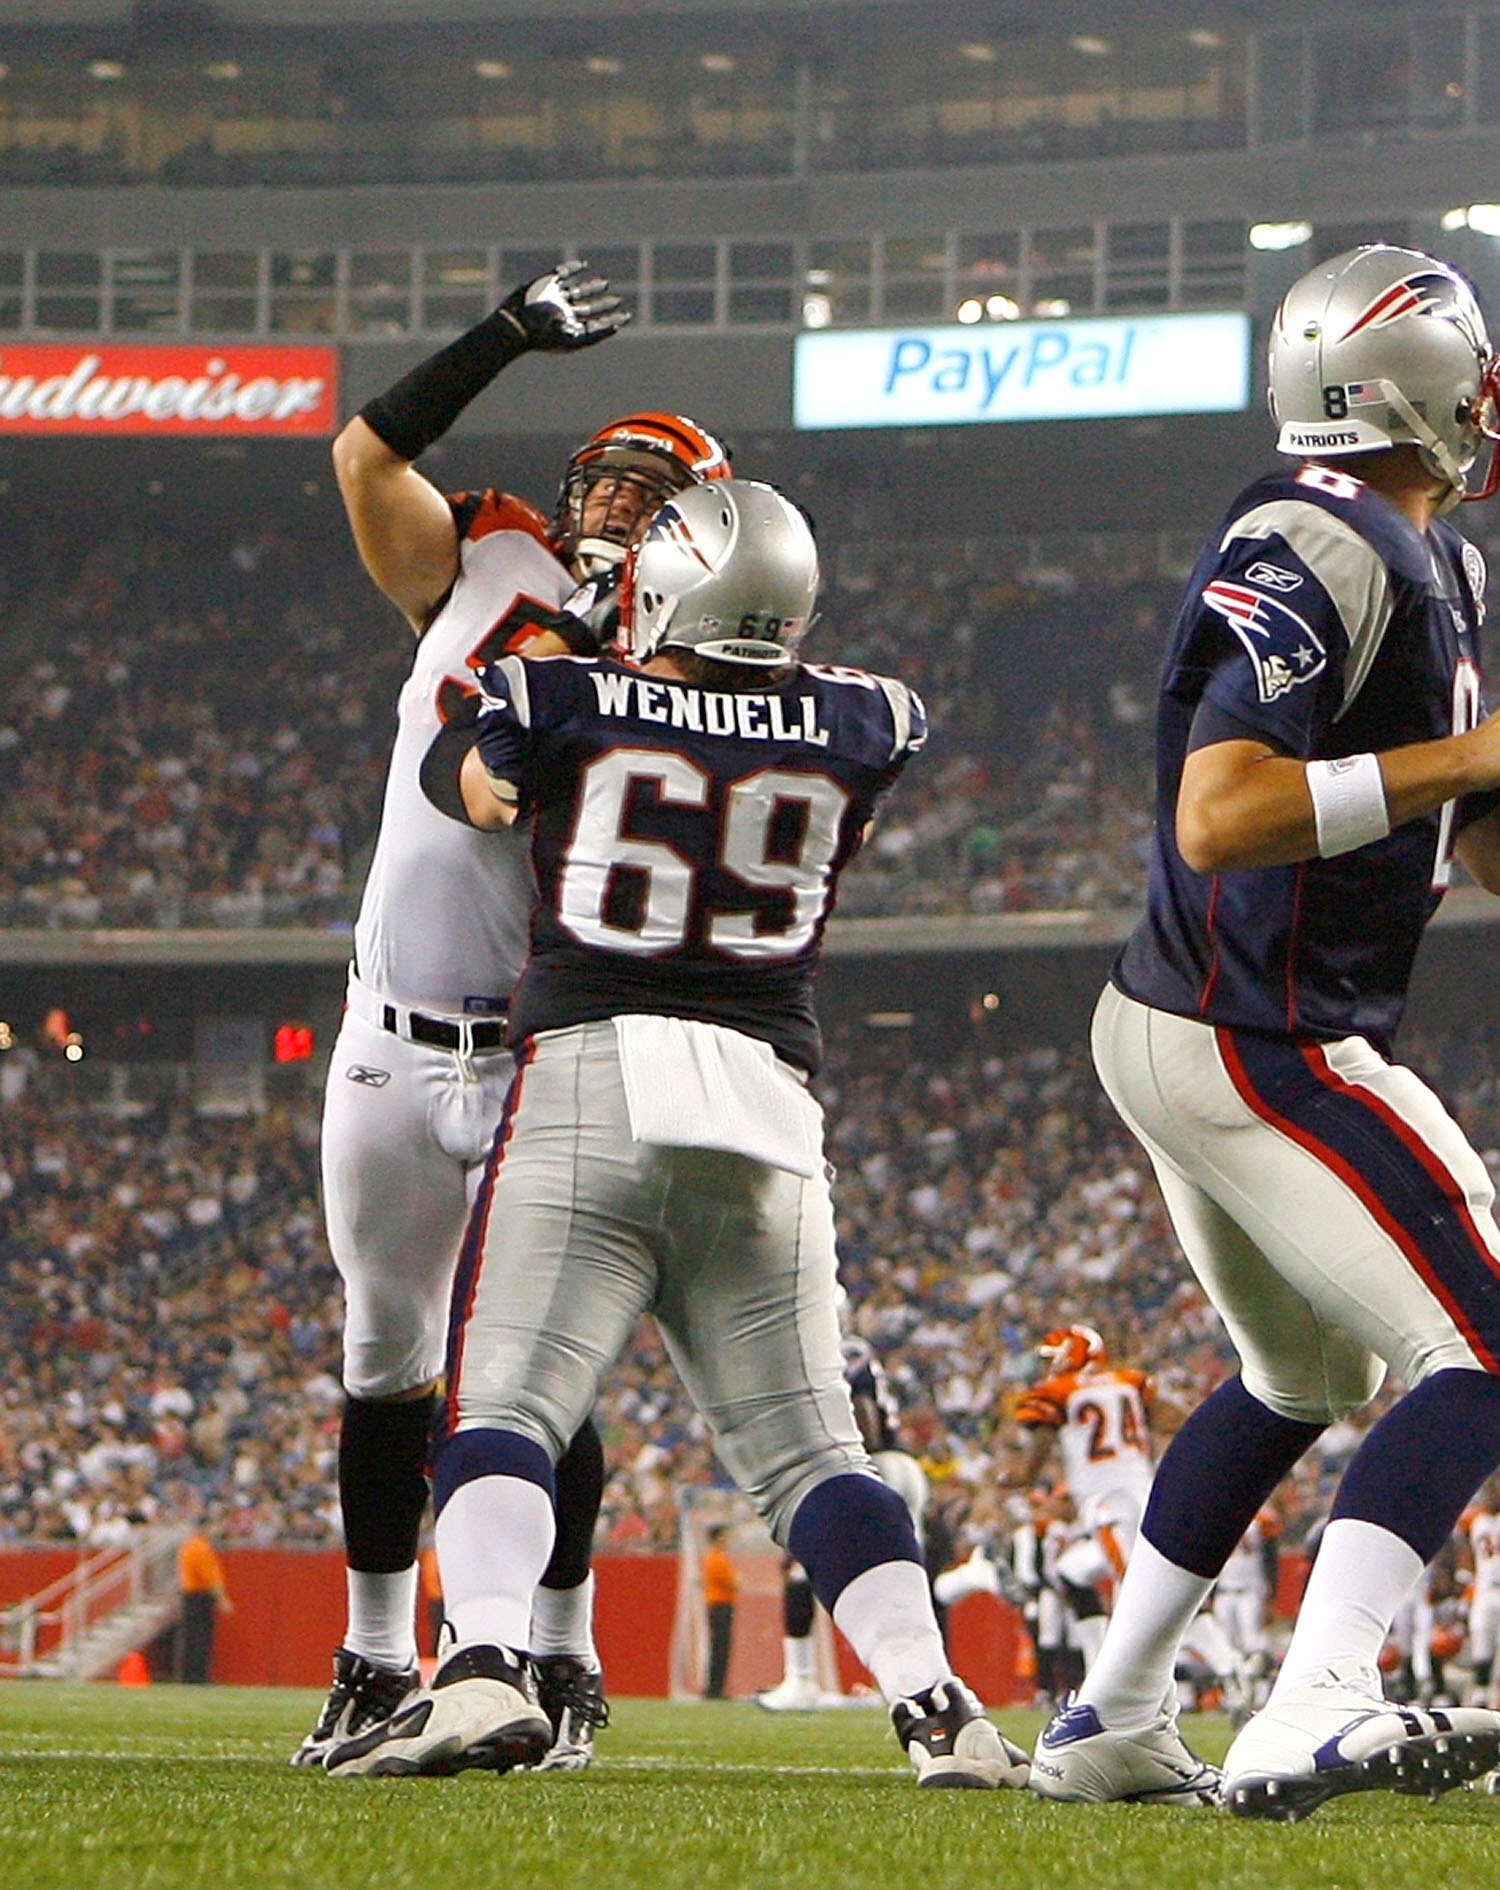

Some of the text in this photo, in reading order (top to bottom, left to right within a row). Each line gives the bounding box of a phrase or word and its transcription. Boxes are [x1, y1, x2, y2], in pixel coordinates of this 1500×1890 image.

[0, 354, 326, 421] udweiser
[883, 326, 1137, 413] PayPal
[1322, 384, 1348, 419] 8
[1289, 431, 1360, 448] PATRIOTS
[738, 613, 782, 642] 69
[589, 671, 829, 747] WENDELL
[558, 745, 852, 961] 69
